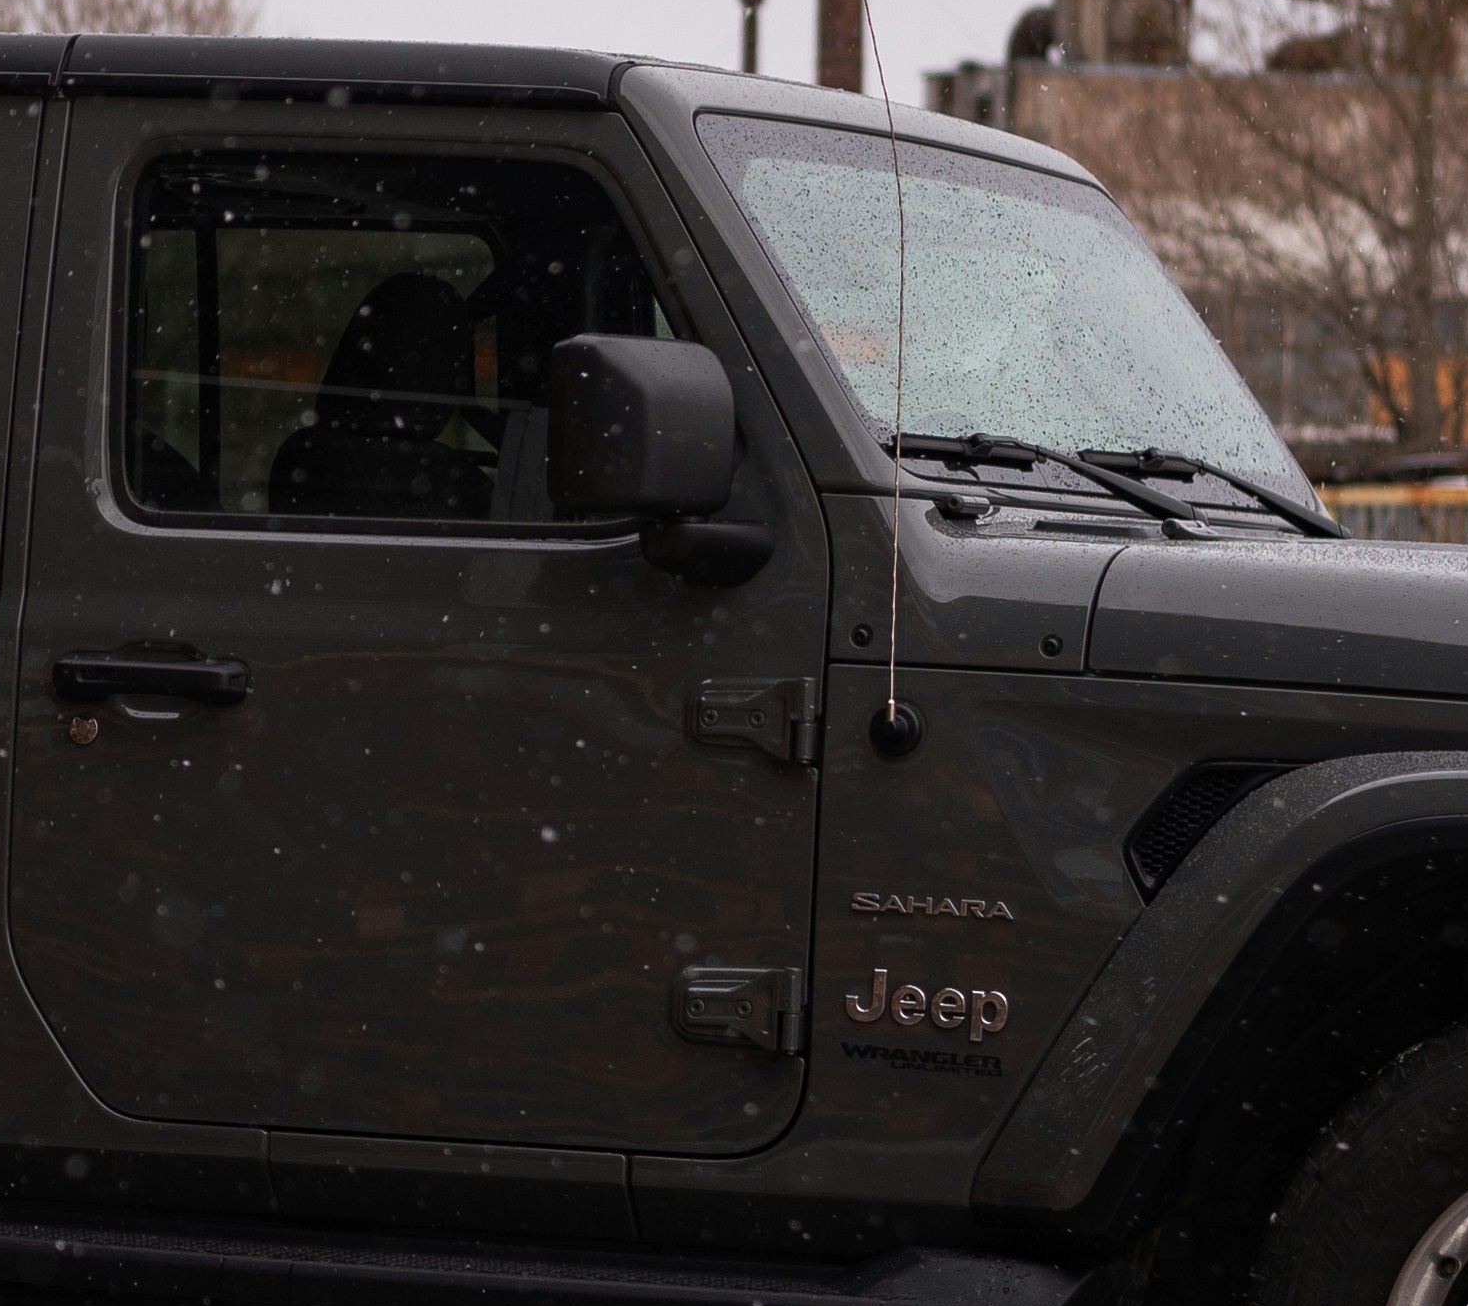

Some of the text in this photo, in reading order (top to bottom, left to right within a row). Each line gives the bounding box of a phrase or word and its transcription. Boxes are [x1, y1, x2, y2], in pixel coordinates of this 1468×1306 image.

[850, 892, 1014, 920] SAHARA
[845, 968, 1009, 1041] Jeep
[840, 1041, 1003, 1070] WRANGLER
[890, 1061, 1003, 1077] UNLIMITED
